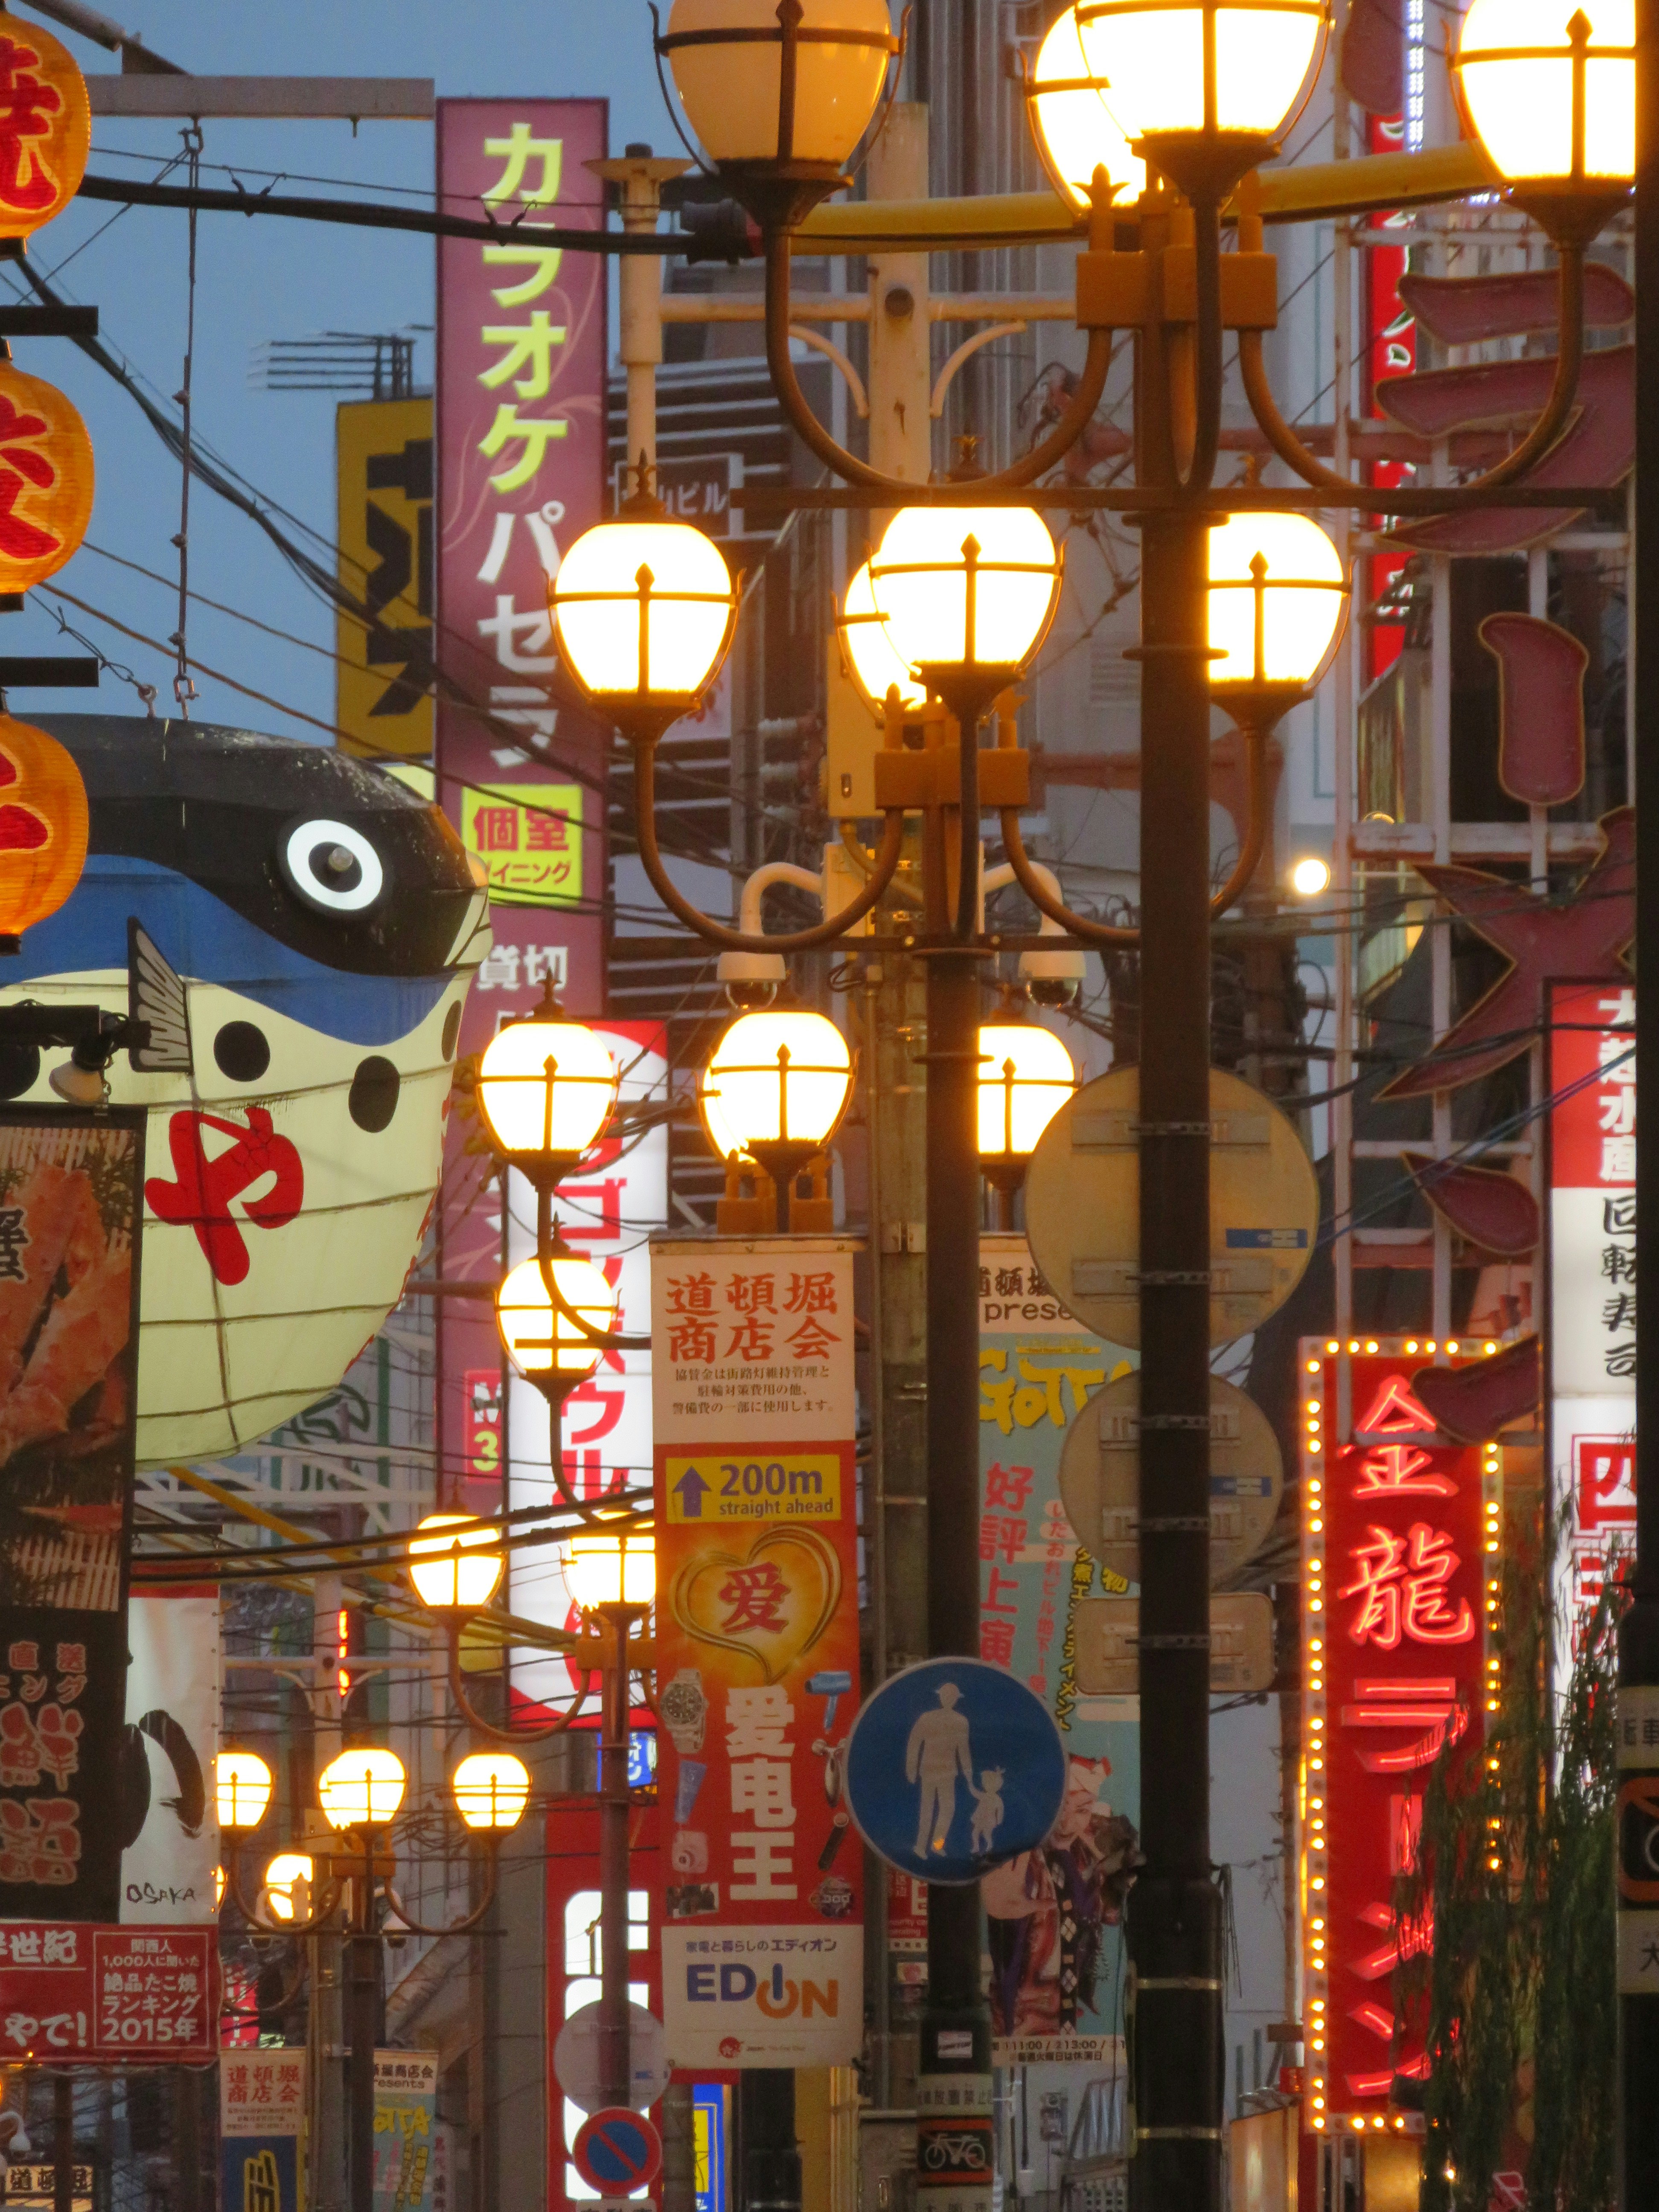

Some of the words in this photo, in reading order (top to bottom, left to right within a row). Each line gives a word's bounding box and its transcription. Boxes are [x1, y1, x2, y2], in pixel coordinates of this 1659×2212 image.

[477, 123, 568, 494] カラオケ
[474, 806, 569, 852] 個室
[487, 859, 573, 886] イニング
[475, 944, 568, 991] 貸切
[665, 1271, 838, 1317] 道頓堀
[665, 1315, 842, 1365] 商店会
[719, 1463, 823, 1497] 200m
[719, 1499, 781, 1519] straight
[786, 1497, 835, 1514] ahead
[126, 1883, 196, 1904] OSAKA
[686, 1940, 768, 1953] 家電と暮らしの
[770, 1938, 838, 1953] エディオン
[102, 1994, 201, 2015] ランキング
[686, 1963, 839, 2019] EDION
[102, 2017, 199, 2042] 2015年
[227, 2064, 300, 2084] 道頓堀
[227, 2084, 300, 2103] 商店会
